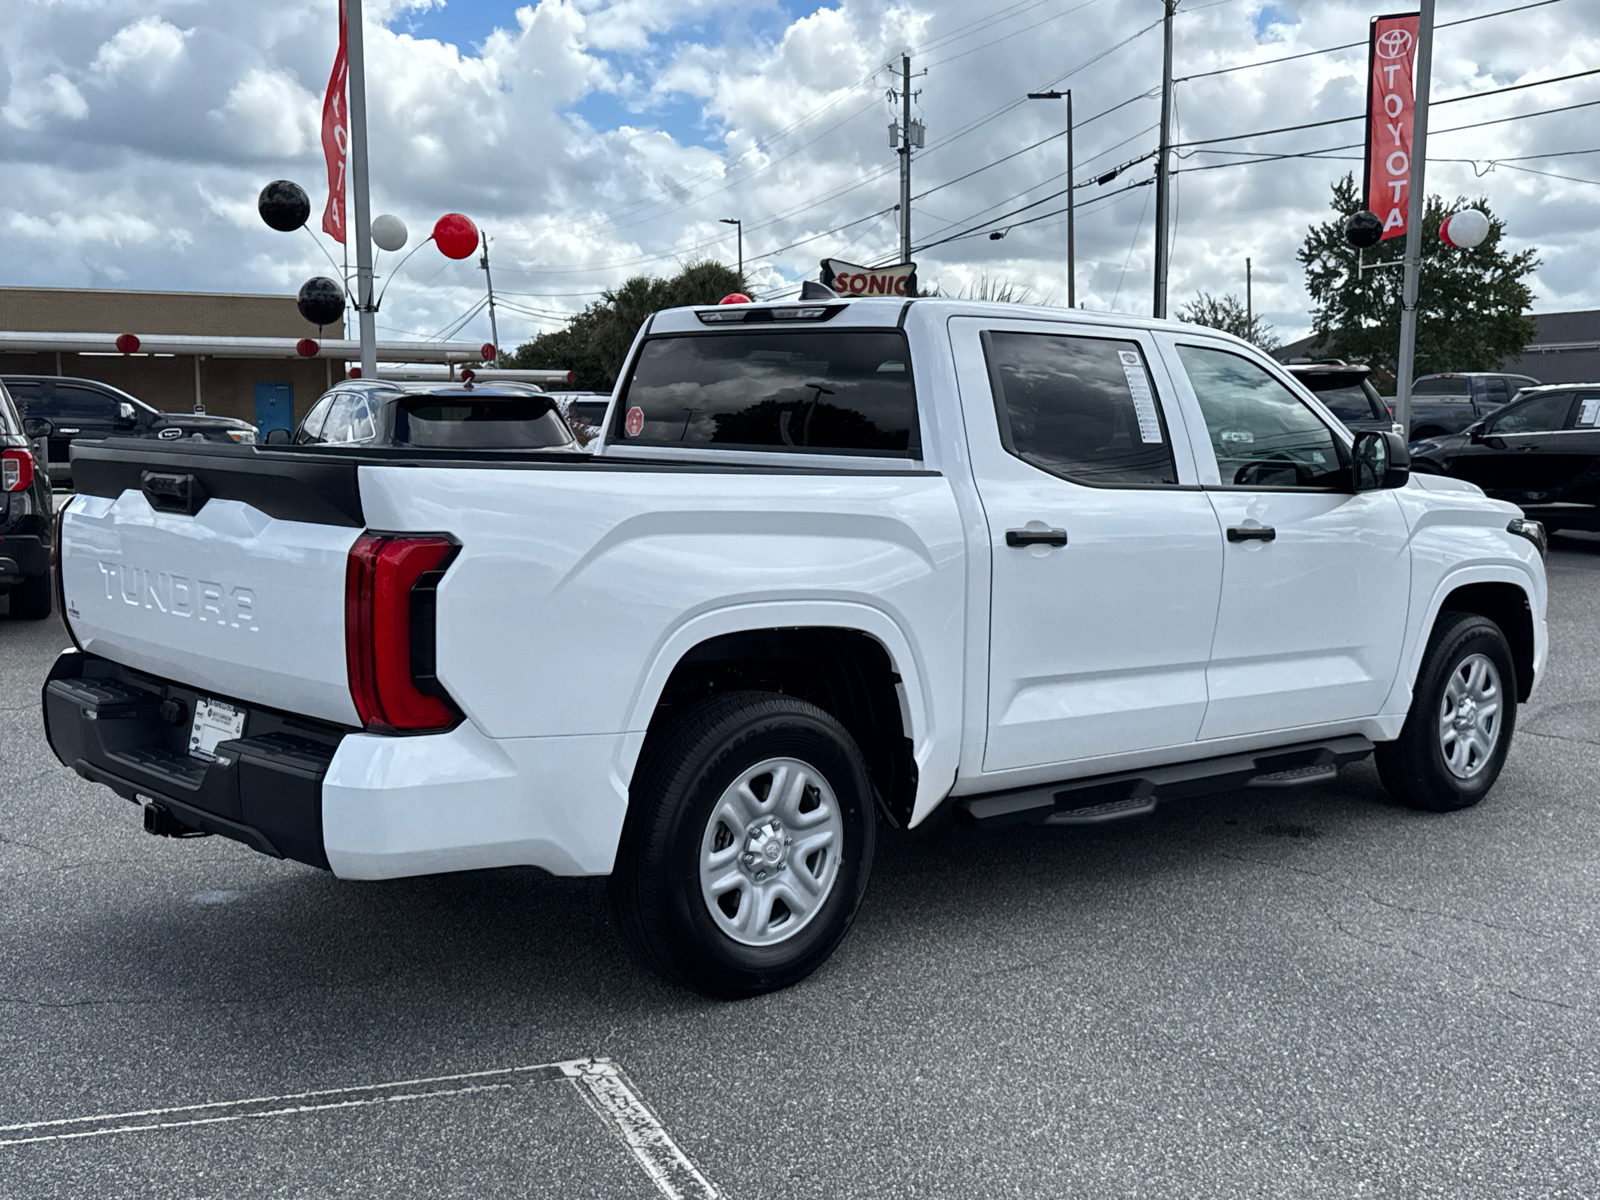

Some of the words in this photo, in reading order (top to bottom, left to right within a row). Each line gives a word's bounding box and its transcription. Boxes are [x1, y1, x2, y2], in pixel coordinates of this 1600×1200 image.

[1383, 65, 1409, 232] TOYOTA
[835, 272, 909, 295] SONIC
[98, 560, 259, 632] TUNDRA
